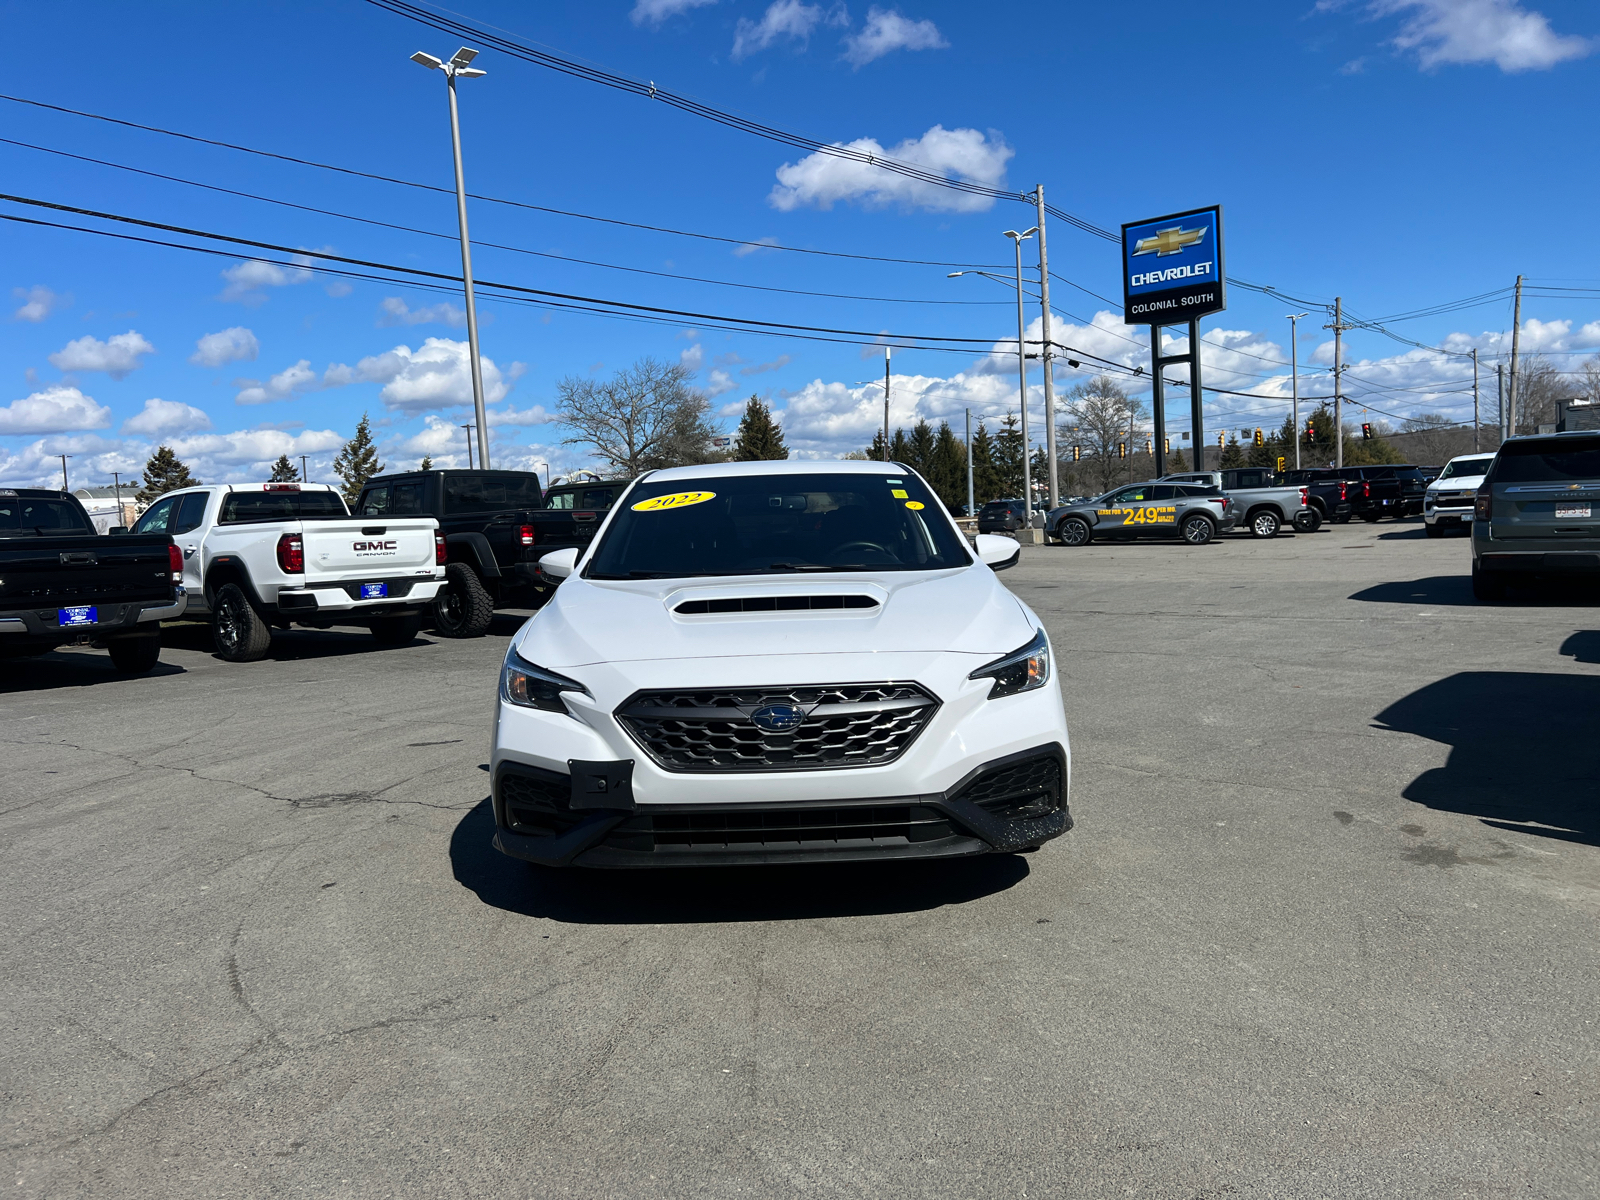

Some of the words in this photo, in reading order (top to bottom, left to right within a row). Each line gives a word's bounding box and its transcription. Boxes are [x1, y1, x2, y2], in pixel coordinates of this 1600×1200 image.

[1131, 261, 1212, 287] CHEVROLET
[1131, 299, 1178, 314] COLONIAL
[1181, 293, 1214, 306] SOUTH
[648, 493, 702, 509] 2022
[353, 541, 397, 551] GMC
